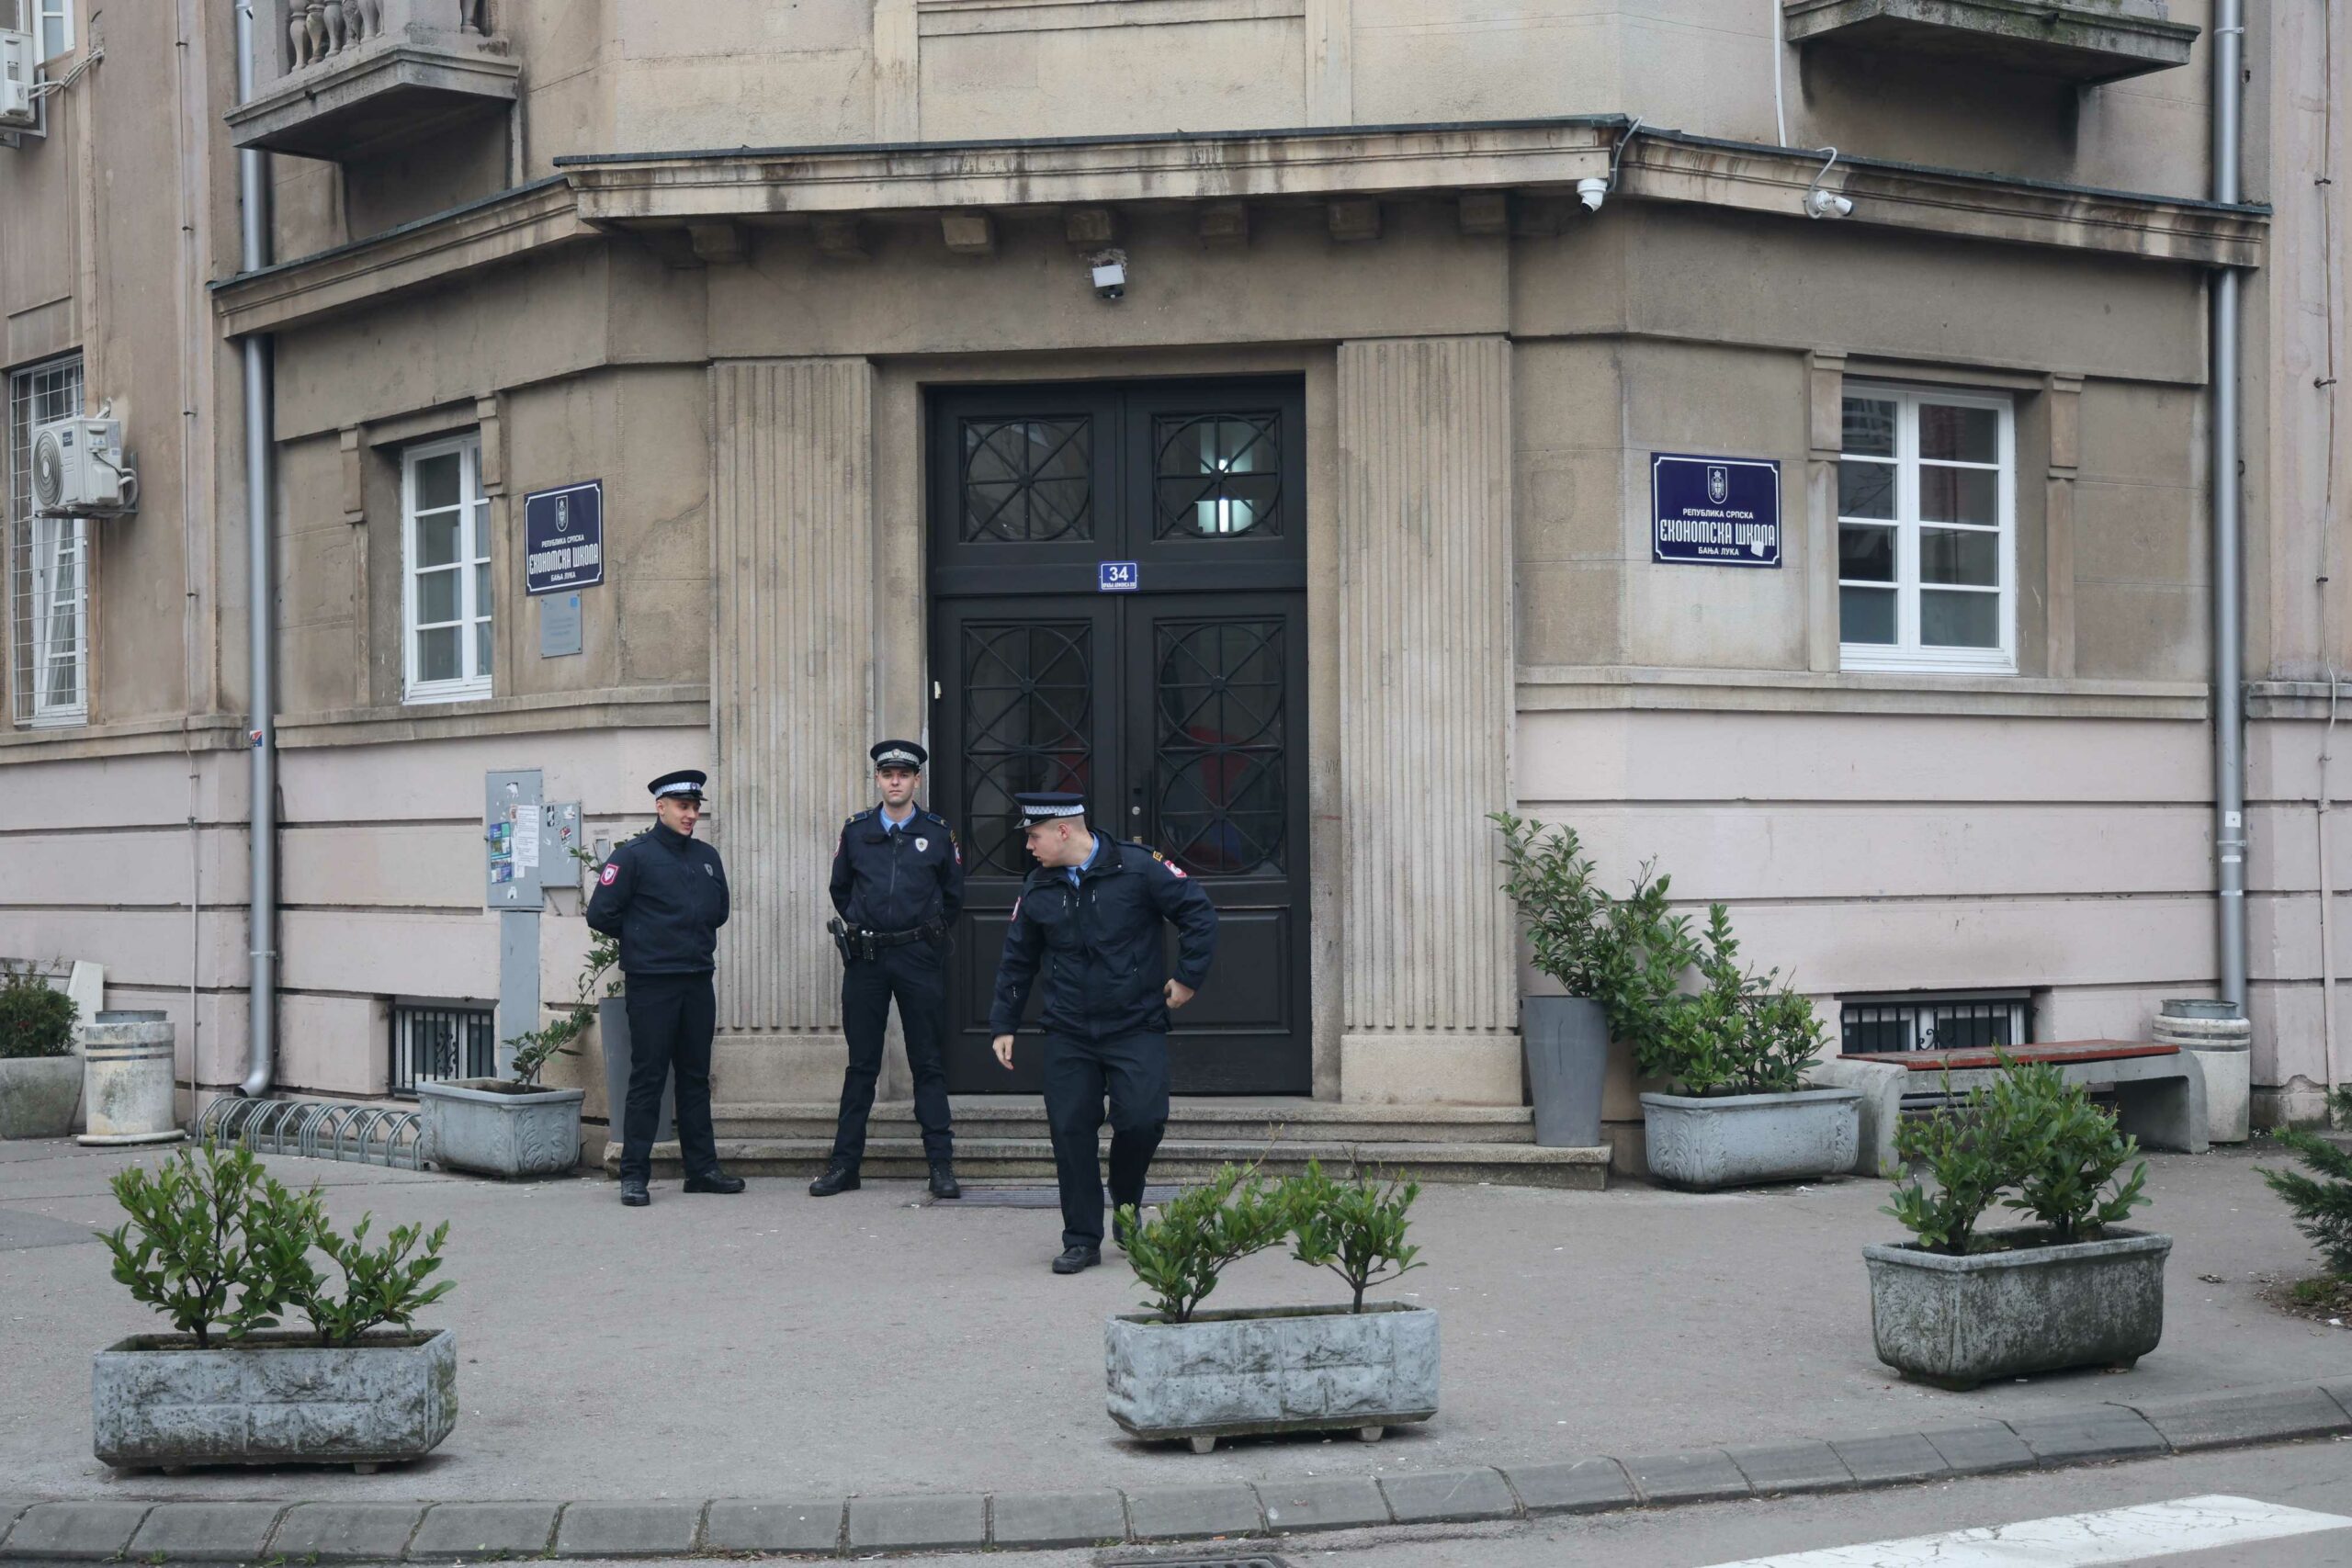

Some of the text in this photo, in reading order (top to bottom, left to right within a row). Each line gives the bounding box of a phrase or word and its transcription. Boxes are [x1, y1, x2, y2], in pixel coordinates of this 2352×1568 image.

[1683, 508, 1754, 519] РЕПУБЛИКА СРПСКА
[1660, 519, 1775, 547] ЕКОНОМСКА ШКОЛА
[1698, 547, 1740, 556] БАЊА ЛУКА
[1109, 566, 1129, 581] 34
